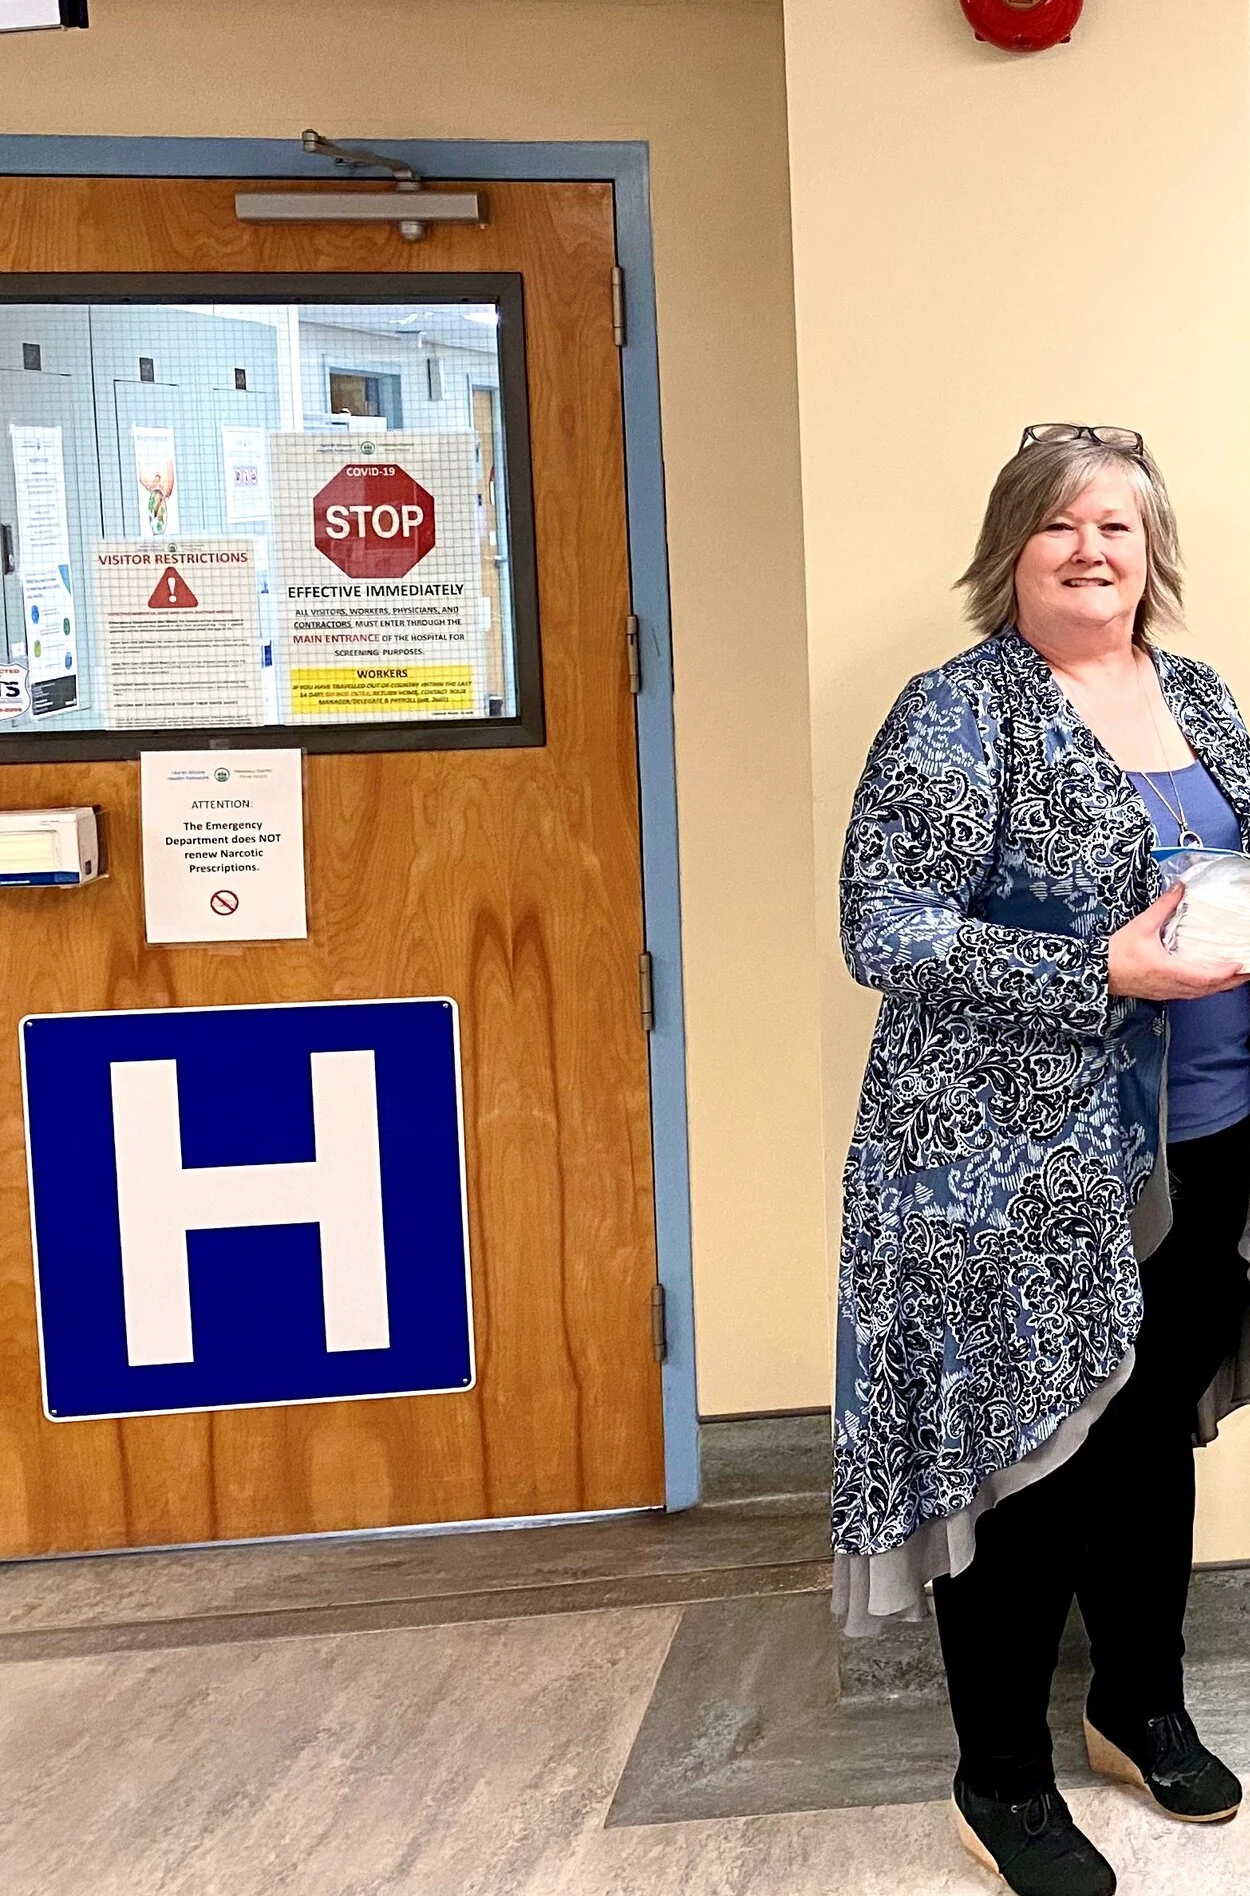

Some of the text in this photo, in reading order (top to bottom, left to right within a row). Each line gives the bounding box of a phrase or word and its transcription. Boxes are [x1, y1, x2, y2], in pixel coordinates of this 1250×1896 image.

[346, 467, 396, 477] COVID-19
[326, 505, 424, 539] STOP
[99, 552, 248, 565] VISITOR RESTRICTIONS
[289, 584, 464, 598] EFFECTIVE IMMEDIATELY
[356, 620, 378, 628] MUST
[407, 619, 445, 627] THROUGH
[293, 635, 322, 644] MAIN
[326, 634, 380, 643] ENTRANCE
[357, 669, 408, 679] WORKERS
[192, 800, 253, 809] ATTENTION:
[184, 821, 263, 831] The Emergency
[166, 834, 281, 846] Department does NOT
[221, 849, 264, 858] Narcotic
[189, 864, 260, 874] Prescriptions.
[110, 1050, 391, 1367] H
